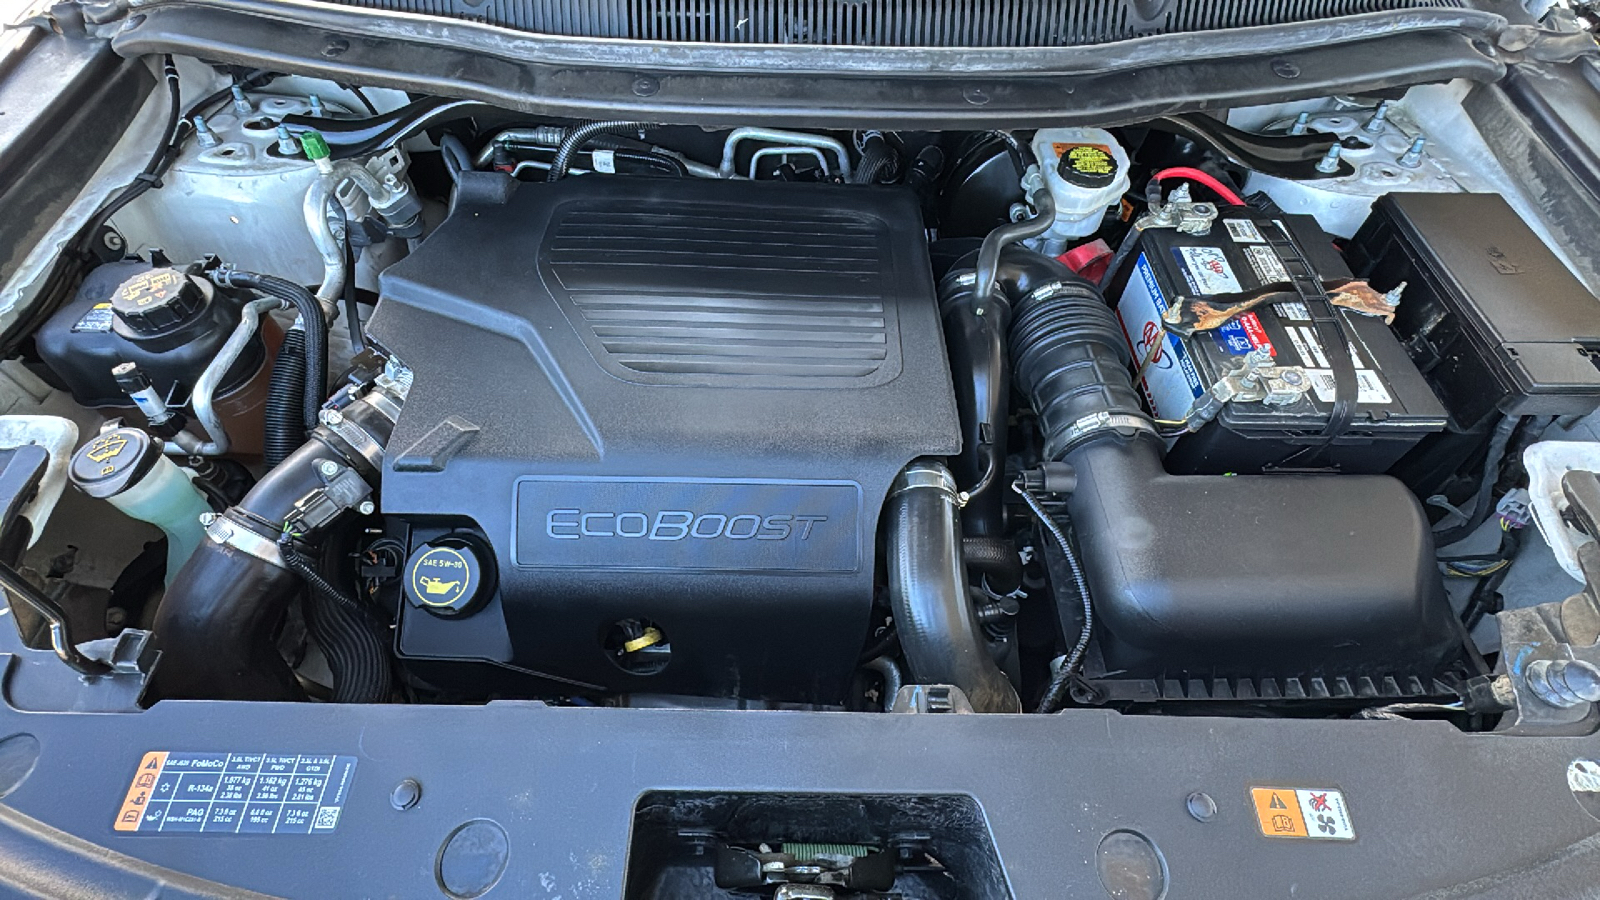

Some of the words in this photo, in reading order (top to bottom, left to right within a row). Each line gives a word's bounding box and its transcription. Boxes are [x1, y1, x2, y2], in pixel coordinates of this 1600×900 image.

[1141, 264, 1159, 299] PREMIUM
[423, 558, 438, 567] SAE
[438, 560, 463, 569] 5W-30
[190, 759, 224, 768] FoMoCo
[242, 776, 251, 786] kg
[278, 777, 287, 787] kg
[295, 778, 313, 786] 1.276
[313, 778, 322, 788] kg
[187, 784, 214, 793] R-134a
[186, 807, 204, 817] PAG
